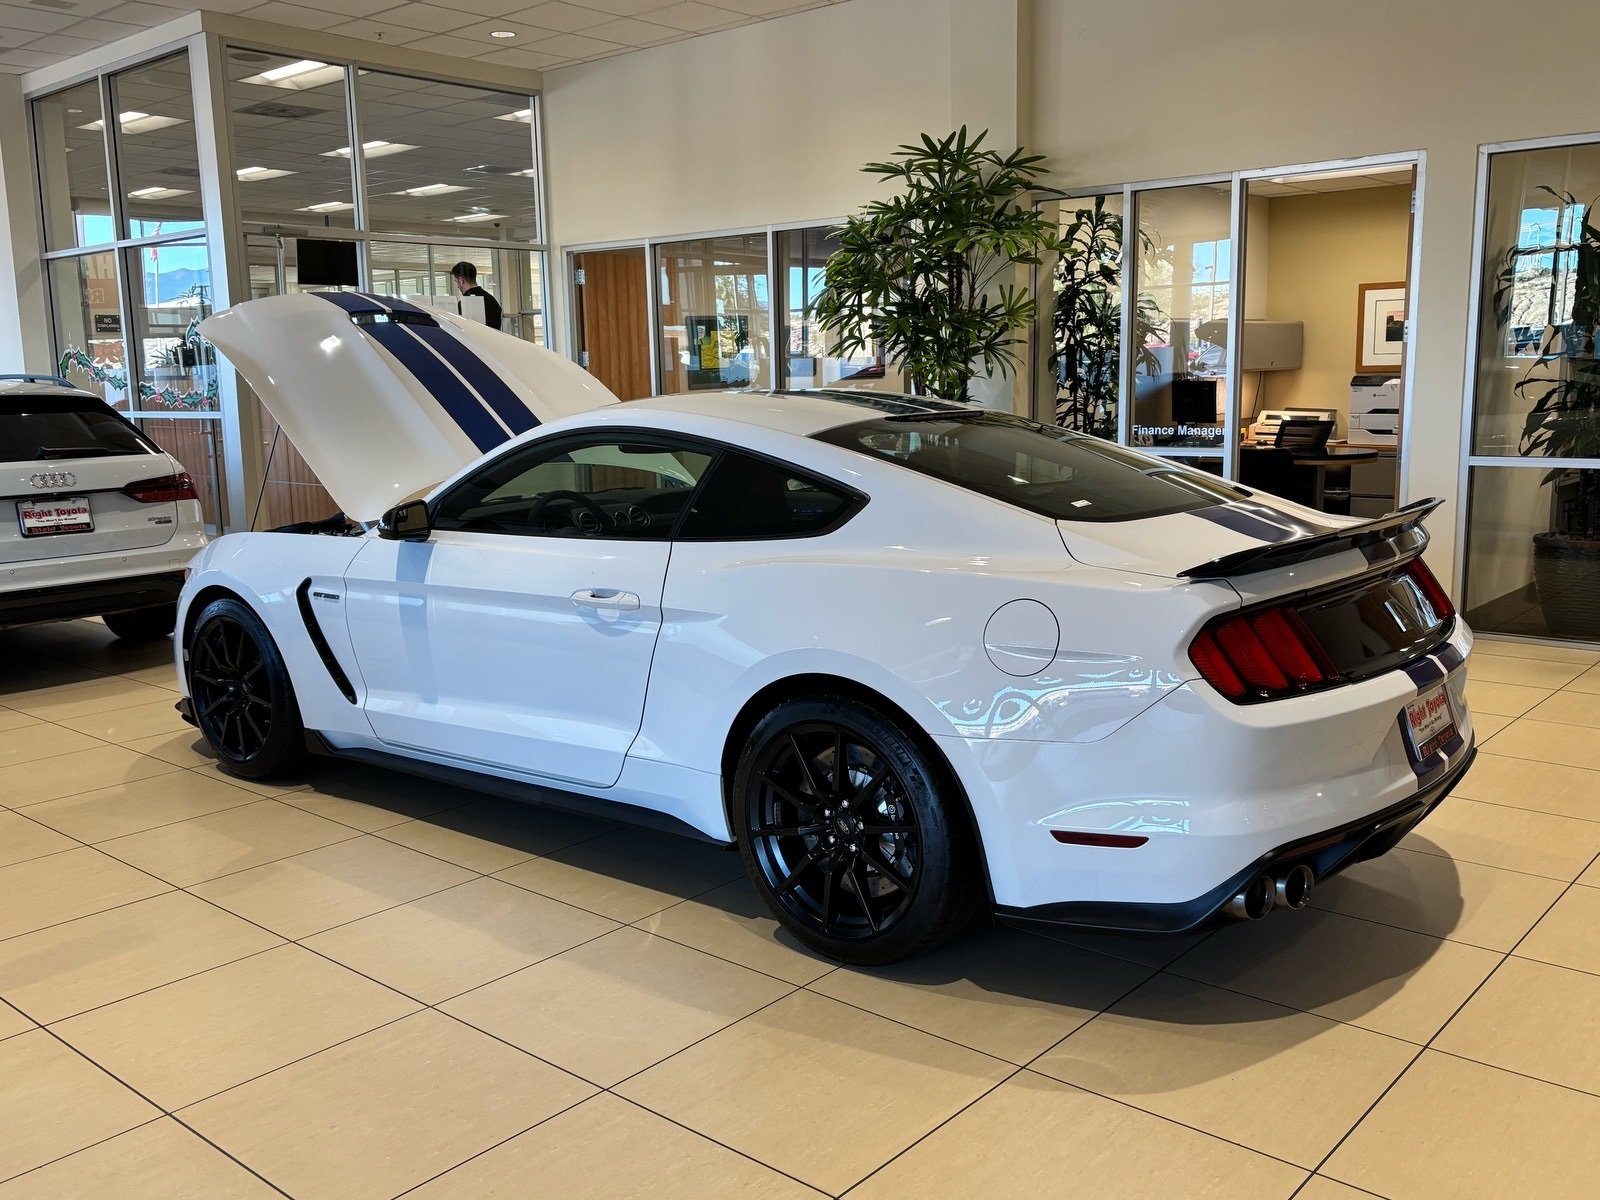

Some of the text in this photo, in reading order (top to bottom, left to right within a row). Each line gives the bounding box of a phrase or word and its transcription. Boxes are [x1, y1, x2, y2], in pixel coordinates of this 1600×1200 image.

[1132, 425, 1174, 435] Finance
[23, 506, 87, 519] Right Toyota
[1408, 692, 1446, 729] Right Toyota
